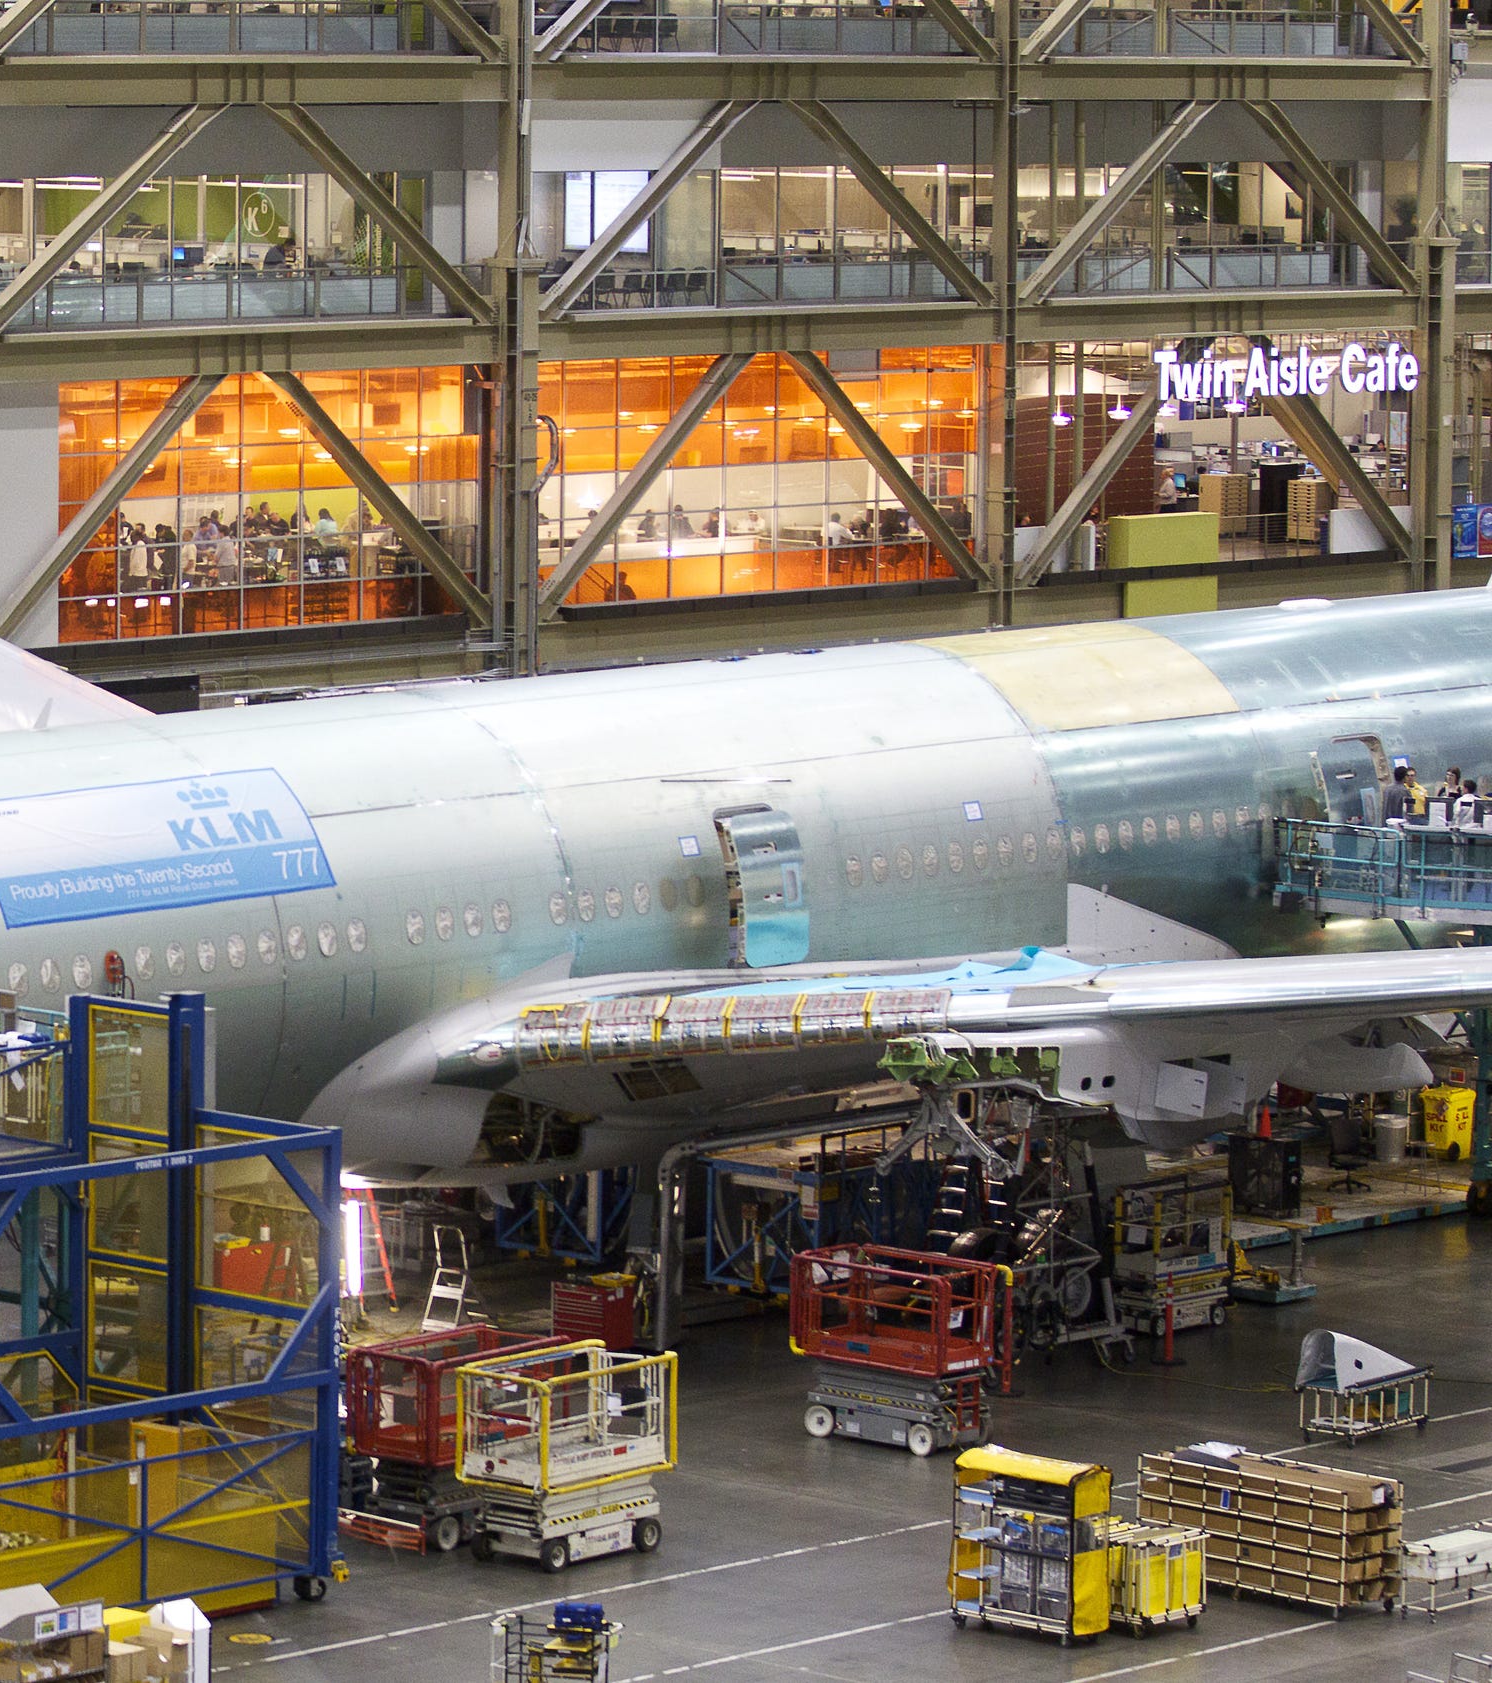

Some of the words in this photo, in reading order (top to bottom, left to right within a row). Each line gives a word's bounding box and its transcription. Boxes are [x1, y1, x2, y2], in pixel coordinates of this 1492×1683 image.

[1154, 349, 1234, 401] Twin
[1244, 346, 1330, 397] Aisle
[1340, 342, 1420, 394] Cafe
[166, 809, 284, 853] KLM
[9, 880, 60, 900] Proudly
[59, 875, 115, 895] Building
[113, 871, 136, 888] the
[134, 858, 235, 884] Twenty-Second
[272, 847, 320, 881] 777
[141, 887, 152, 897] for
[153, 886, 170, 896] KLM
[1429, 1123, 1445, 1133] KIT
